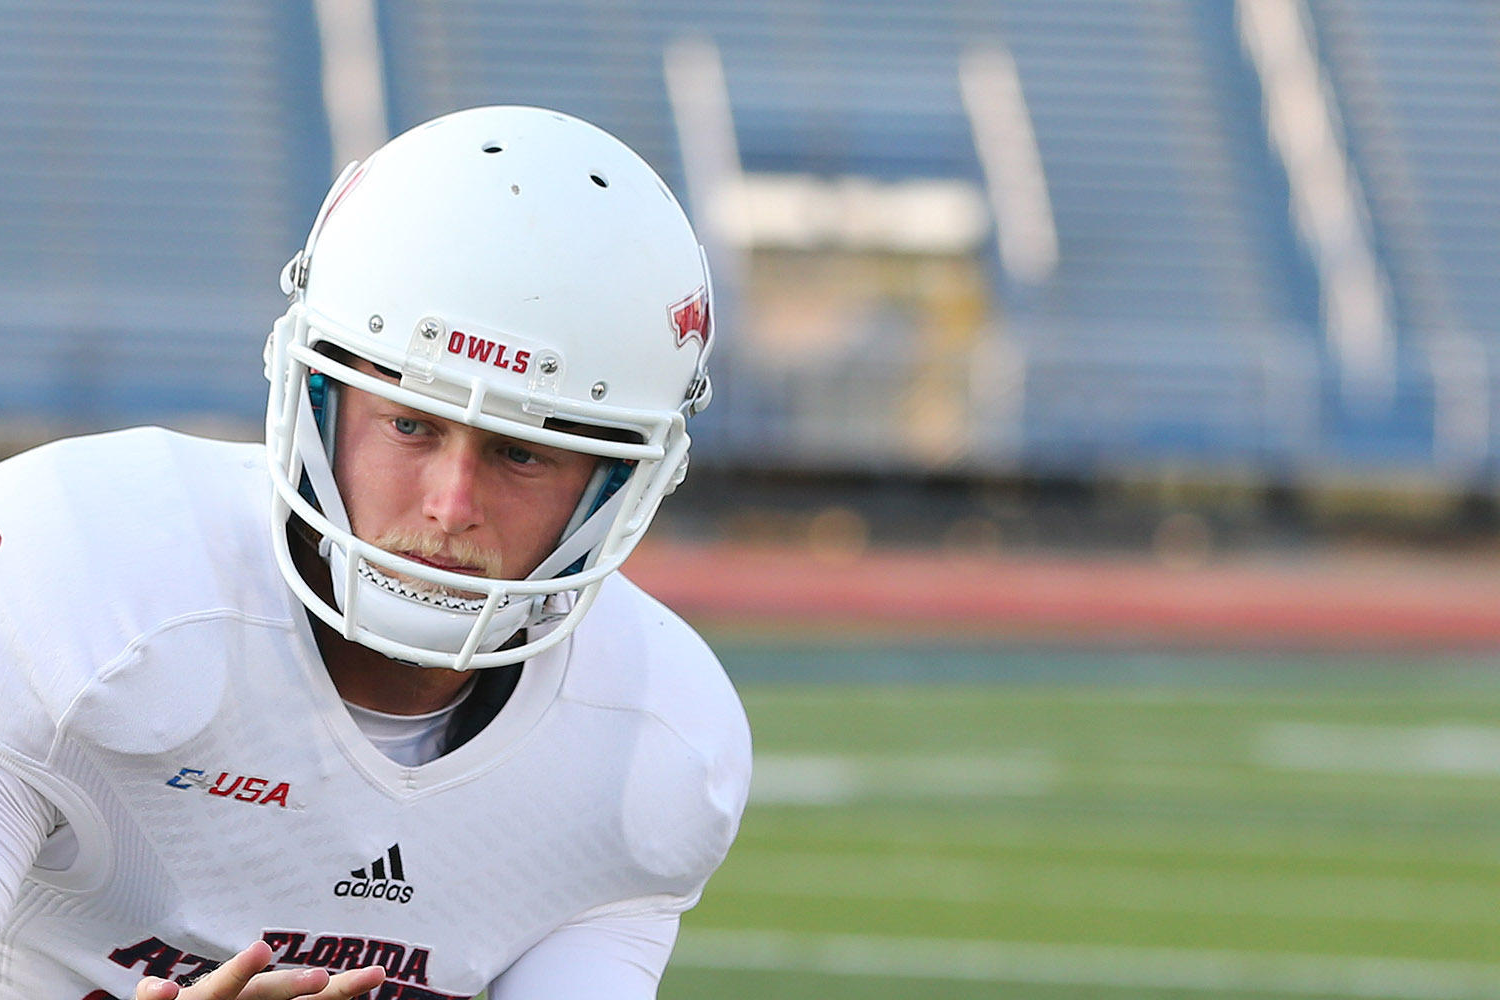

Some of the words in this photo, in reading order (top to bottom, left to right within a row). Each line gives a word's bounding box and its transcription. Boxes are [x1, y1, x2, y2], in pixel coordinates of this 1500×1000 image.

[447, 331, 531, 374] OWLS
[334, 880, 414, 903] adidas
[262, 932, 430, 985] FLORIDA
